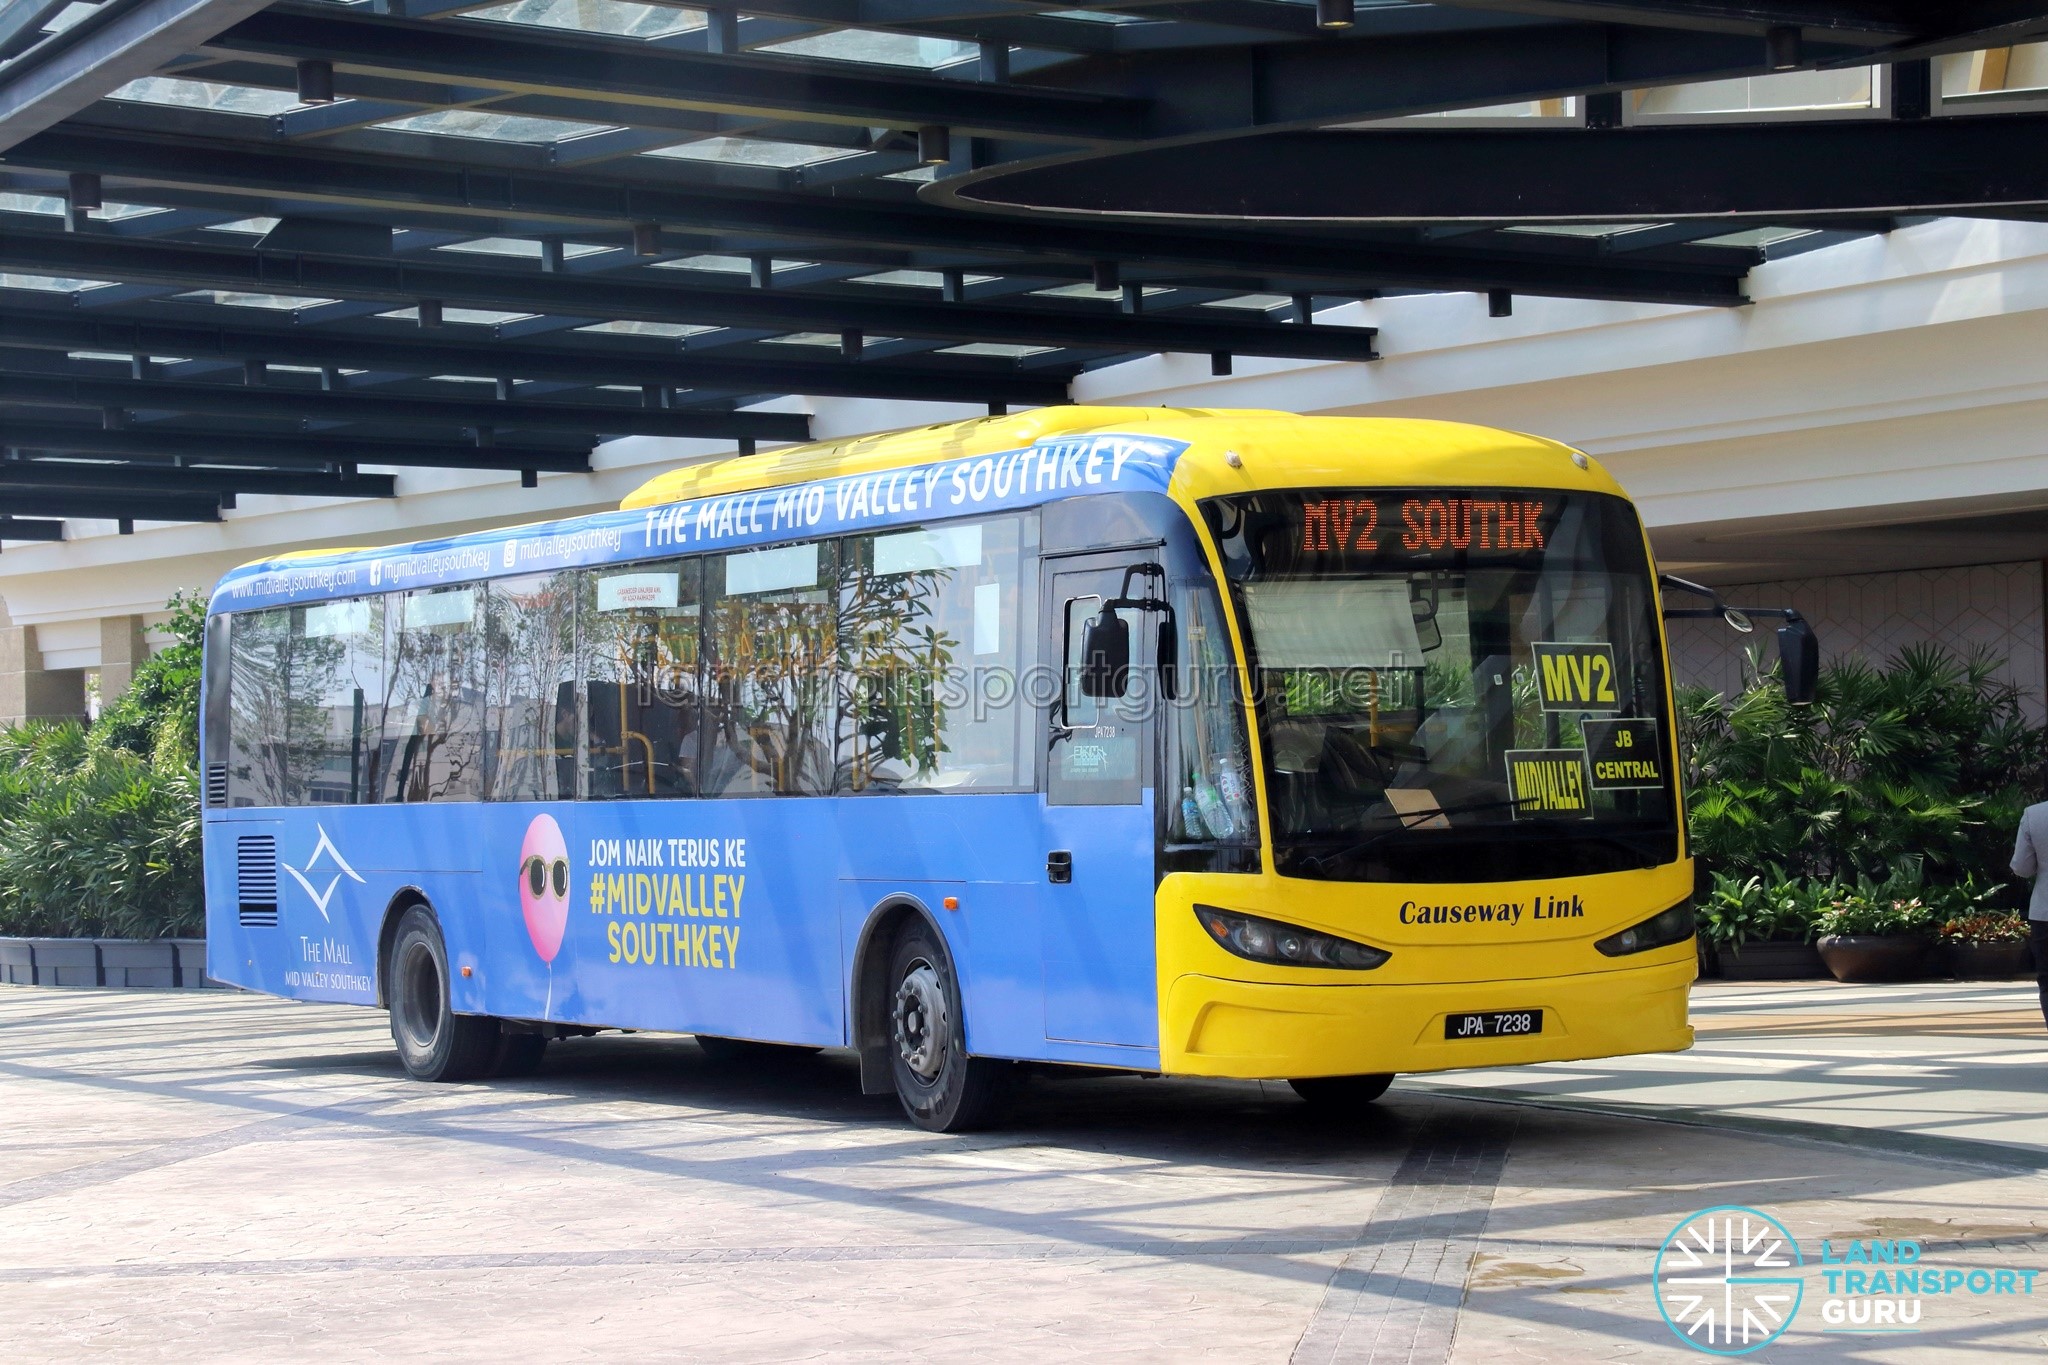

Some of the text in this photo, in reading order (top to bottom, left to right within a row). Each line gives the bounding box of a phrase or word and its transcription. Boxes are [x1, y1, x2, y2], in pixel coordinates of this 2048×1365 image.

[644, 440, 1138, 548] THE MALL MID VALLEY SOUTHKEY
[1303, 499, 1543, 550] MV2 SOUTHK
[519, 527, 622, 560] midvalleysouthkey
[384, 548, 491, 581] mymidvalleysouthkey
[231, 569, 356, 599] www.midvalleysouthkey.com
[1541, 654, 1616, 702] MV2
[1615, 730, 1633, 748] JB
[1513, 761, 1585, 811] MIDVALLEY
[1595, 761, 1658, 779] CENTRAL
[588, 838, 746, 868] JOM NAIK TERUS KE
[590, 872, 745, 918] #MIDVALLEY
[1399, 894, 1584, 926] Causeway Link
[607, 920, 740, 969] SOUTHKEY
[284, 971, 372, 991] MID VALLEY SOUTHKEY
[1457, 1013, 1531, 1036] JPA 7238
